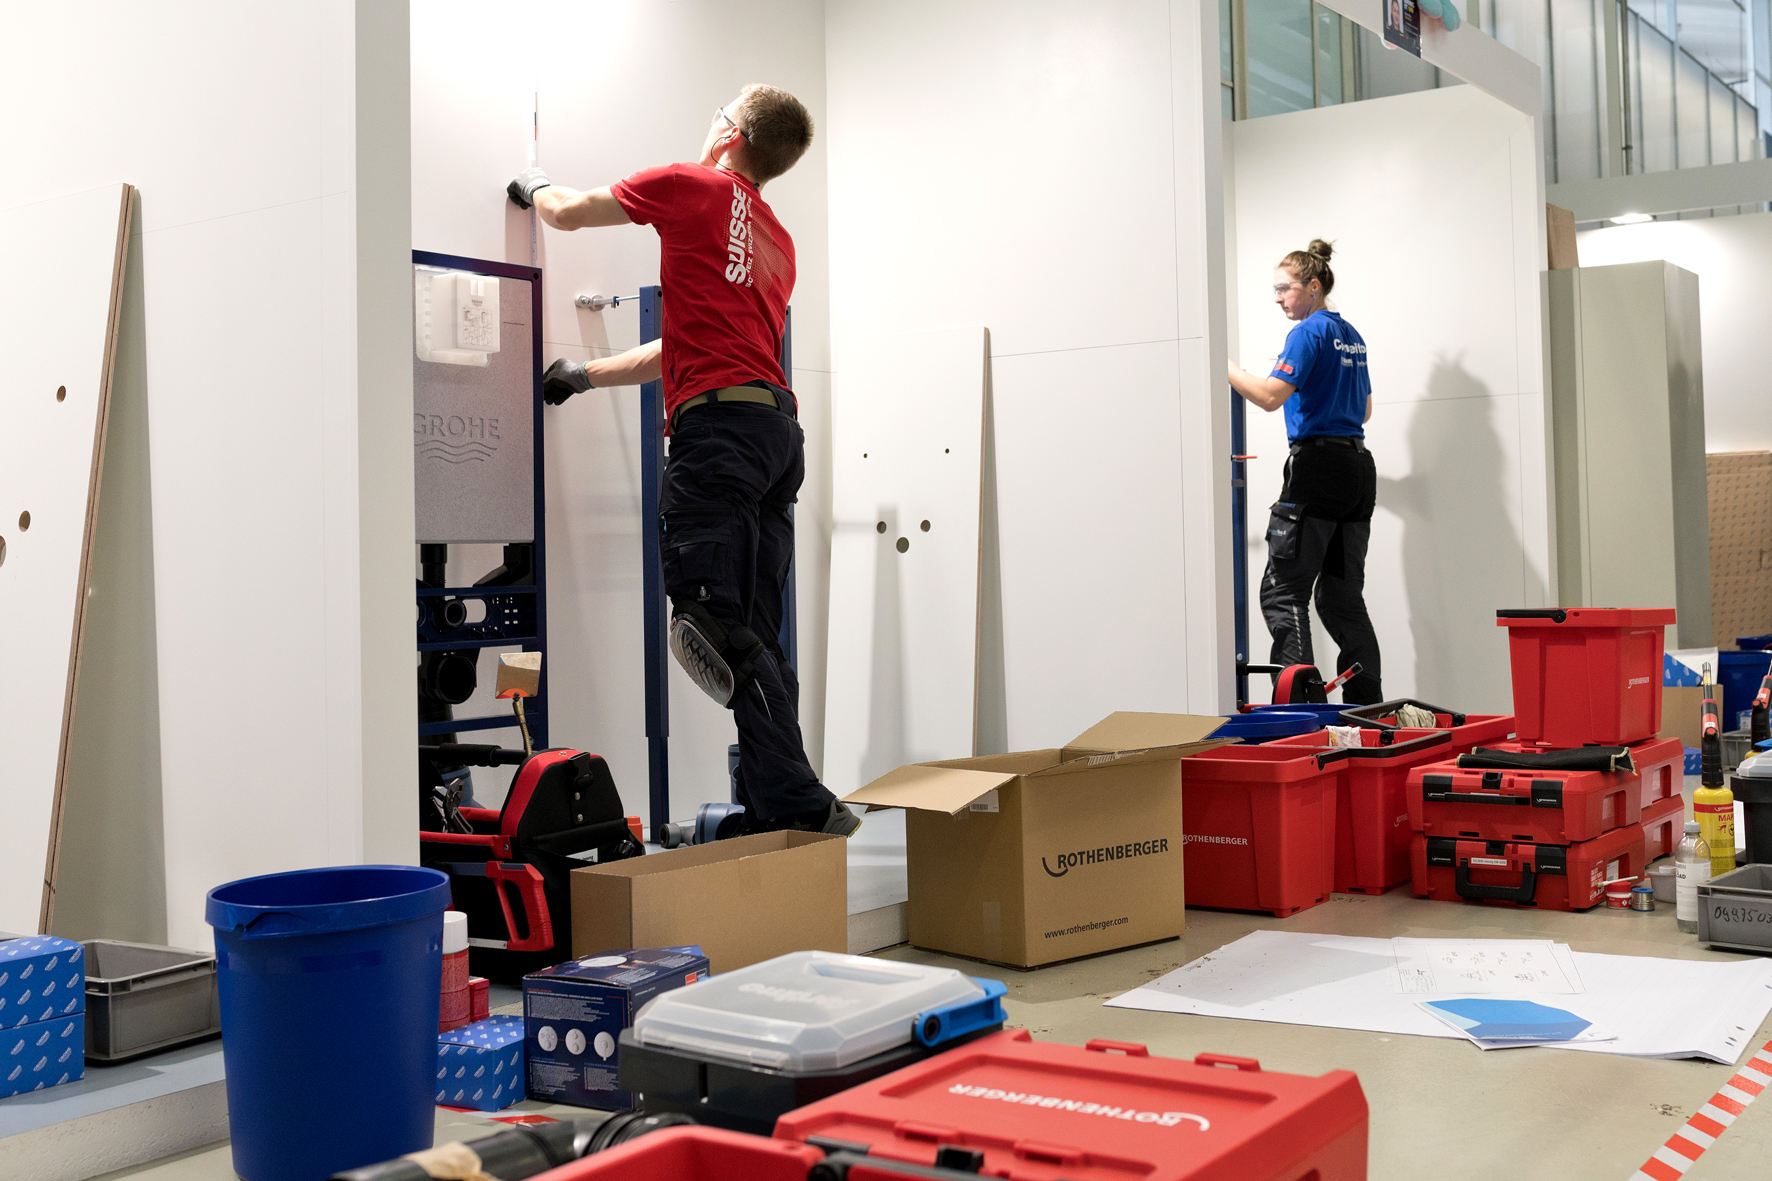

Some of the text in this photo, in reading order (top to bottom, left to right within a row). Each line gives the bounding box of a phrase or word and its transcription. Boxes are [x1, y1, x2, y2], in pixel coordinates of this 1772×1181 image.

[725, 182, 747, 284] SUISSE
[413, 412, 500, 439] GROHE
[1057, 838, 1168, 869] ROTHENBERGER
[1182, 834, 1248, 846] ROTHENBERGER
[1044, 916, 1129, 939] www.rothenberger.com
[948, 1083, 1182, 1127] ROTHENBERGER
